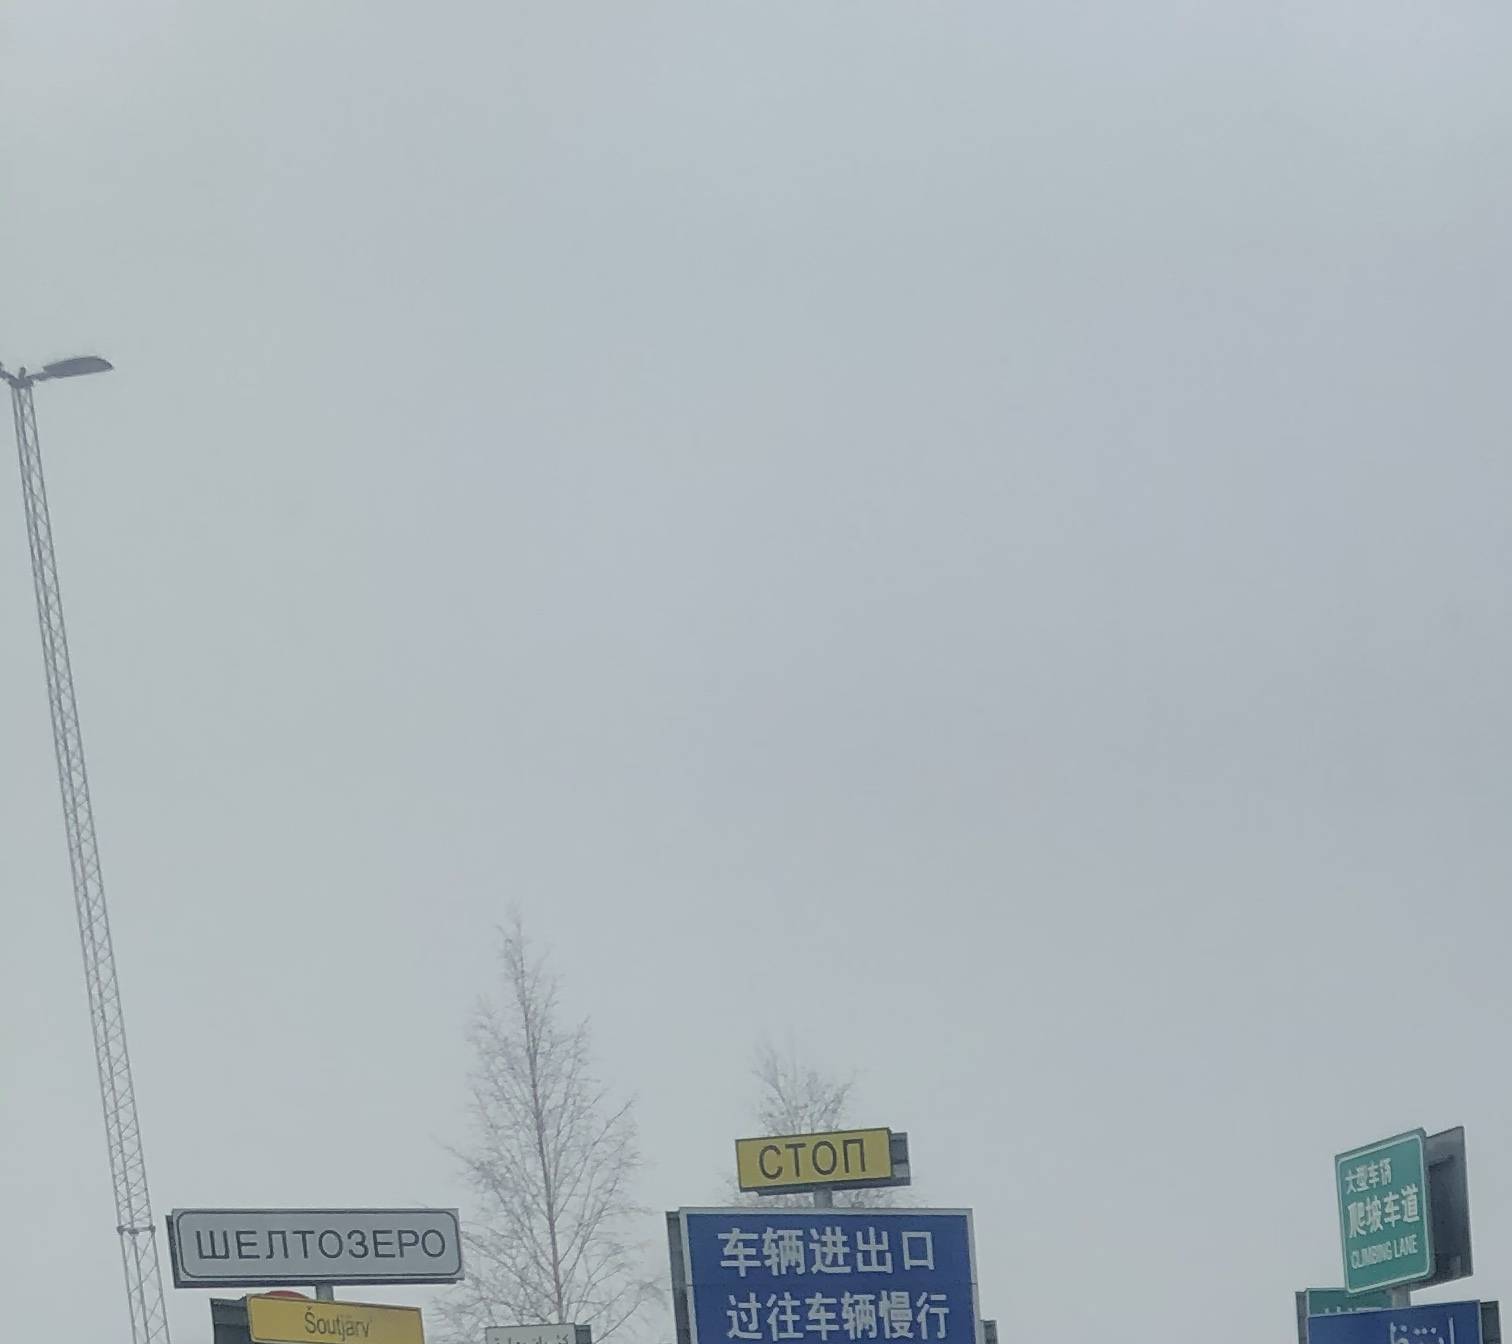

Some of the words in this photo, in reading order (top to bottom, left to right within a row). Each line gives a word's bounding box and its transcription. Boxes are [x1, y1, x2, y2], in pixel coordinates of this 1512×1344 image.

[758, 1138, 867, 1180] СТОП
[1348, 1183, 1421, 1238] 爬坡车道
[195, 1228, 446, 1260] ШЕЛТОЗЕРО
[717, 1226, 936, 1277] 车辆进出口
[1351, 1240, 1393, 1270] CLIMBING
[1393, 1234, 1418, 1258] LANE
[726, 1290, 950, 1342] 过往车辆慢行
